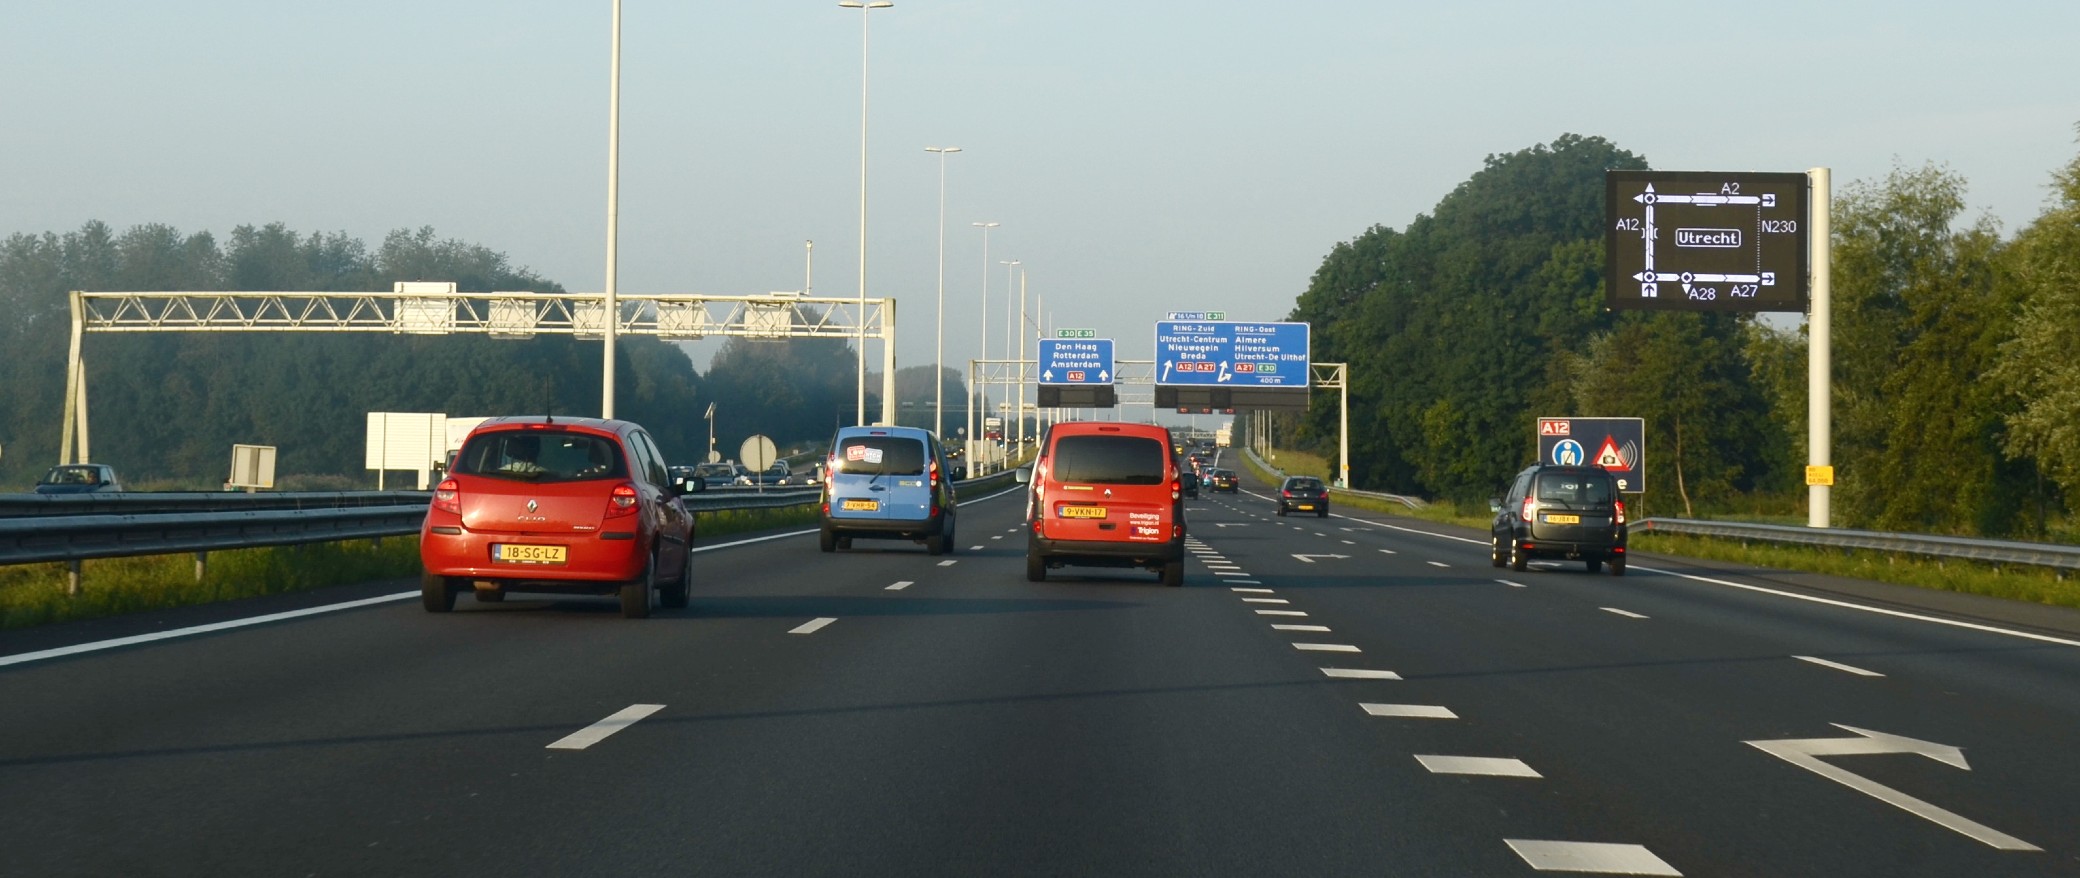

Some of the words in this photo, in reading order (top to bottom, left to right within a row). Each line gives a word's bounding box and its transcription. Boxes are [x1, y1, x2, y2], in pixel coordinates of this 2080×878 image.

[1721, 182, 1740, 195] A2
[1616, 218, 1640, 231] A12
[1761, 220, 1797, 233] N230
[1678, 231, 1737, 245] Utrecht
[1689, 288, 1716, 300] A28
[1730, 285, 1758, 297] A27
[1160, 335, 1228, 343] Utrecht-Centrum
[1235, 336, 1267, 344] Almere
[1075, 343, 1097, 351] Haag
[1168, 344, 1219, 353] Nieuwegein
[1234, 344, 1280, 352] Hilversum
[1180, 352, 1207, 360] Breda
[1234, 352, 1279, 360] Utrecht-De
[1197, 363, 1214, 371] A27
[1069, 372, 1083, 380] A12
[1542, 422, 1569, 434] A12
[1066, 508, 1103, 516] 9-VKN-17
[1137, 526, 1159, 535] Trigion
[507, 547, 560, 560] 18-SG-LZ
